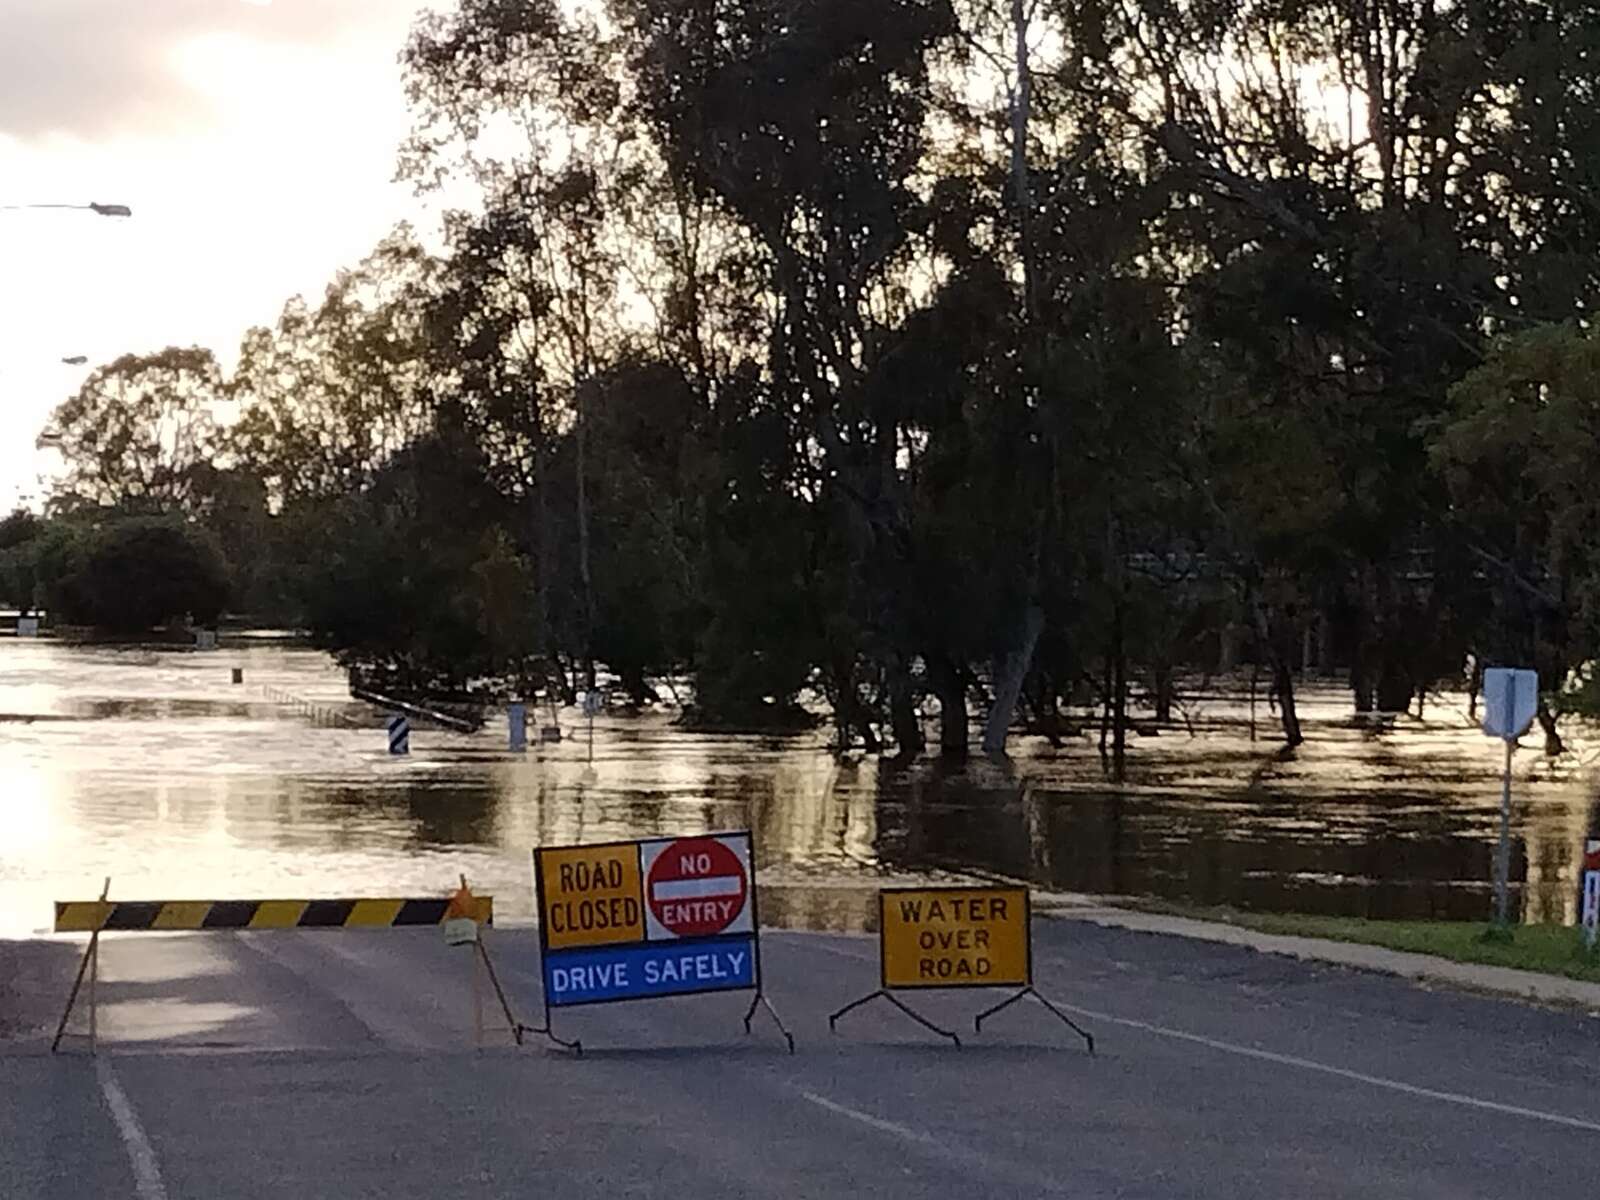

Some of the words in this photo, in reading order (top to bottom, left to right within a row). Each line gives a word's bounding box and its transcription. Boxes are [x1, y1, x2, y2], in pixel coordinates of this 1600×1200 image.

[680, 853, 711, 874] NO
[560, 859, 622, 893] ROAD
[551, 898, 638, 933] CLOSED
[662, 901, 733, 925] ENTRY
[900, 898, 1007, 923] WATER
[919, 929, 990, 950] OVER
[553, 963, 629, 992] DRIVE
[644, 951, 744, 983] SAFELY
[919, 957, 991, 977] ROAD
